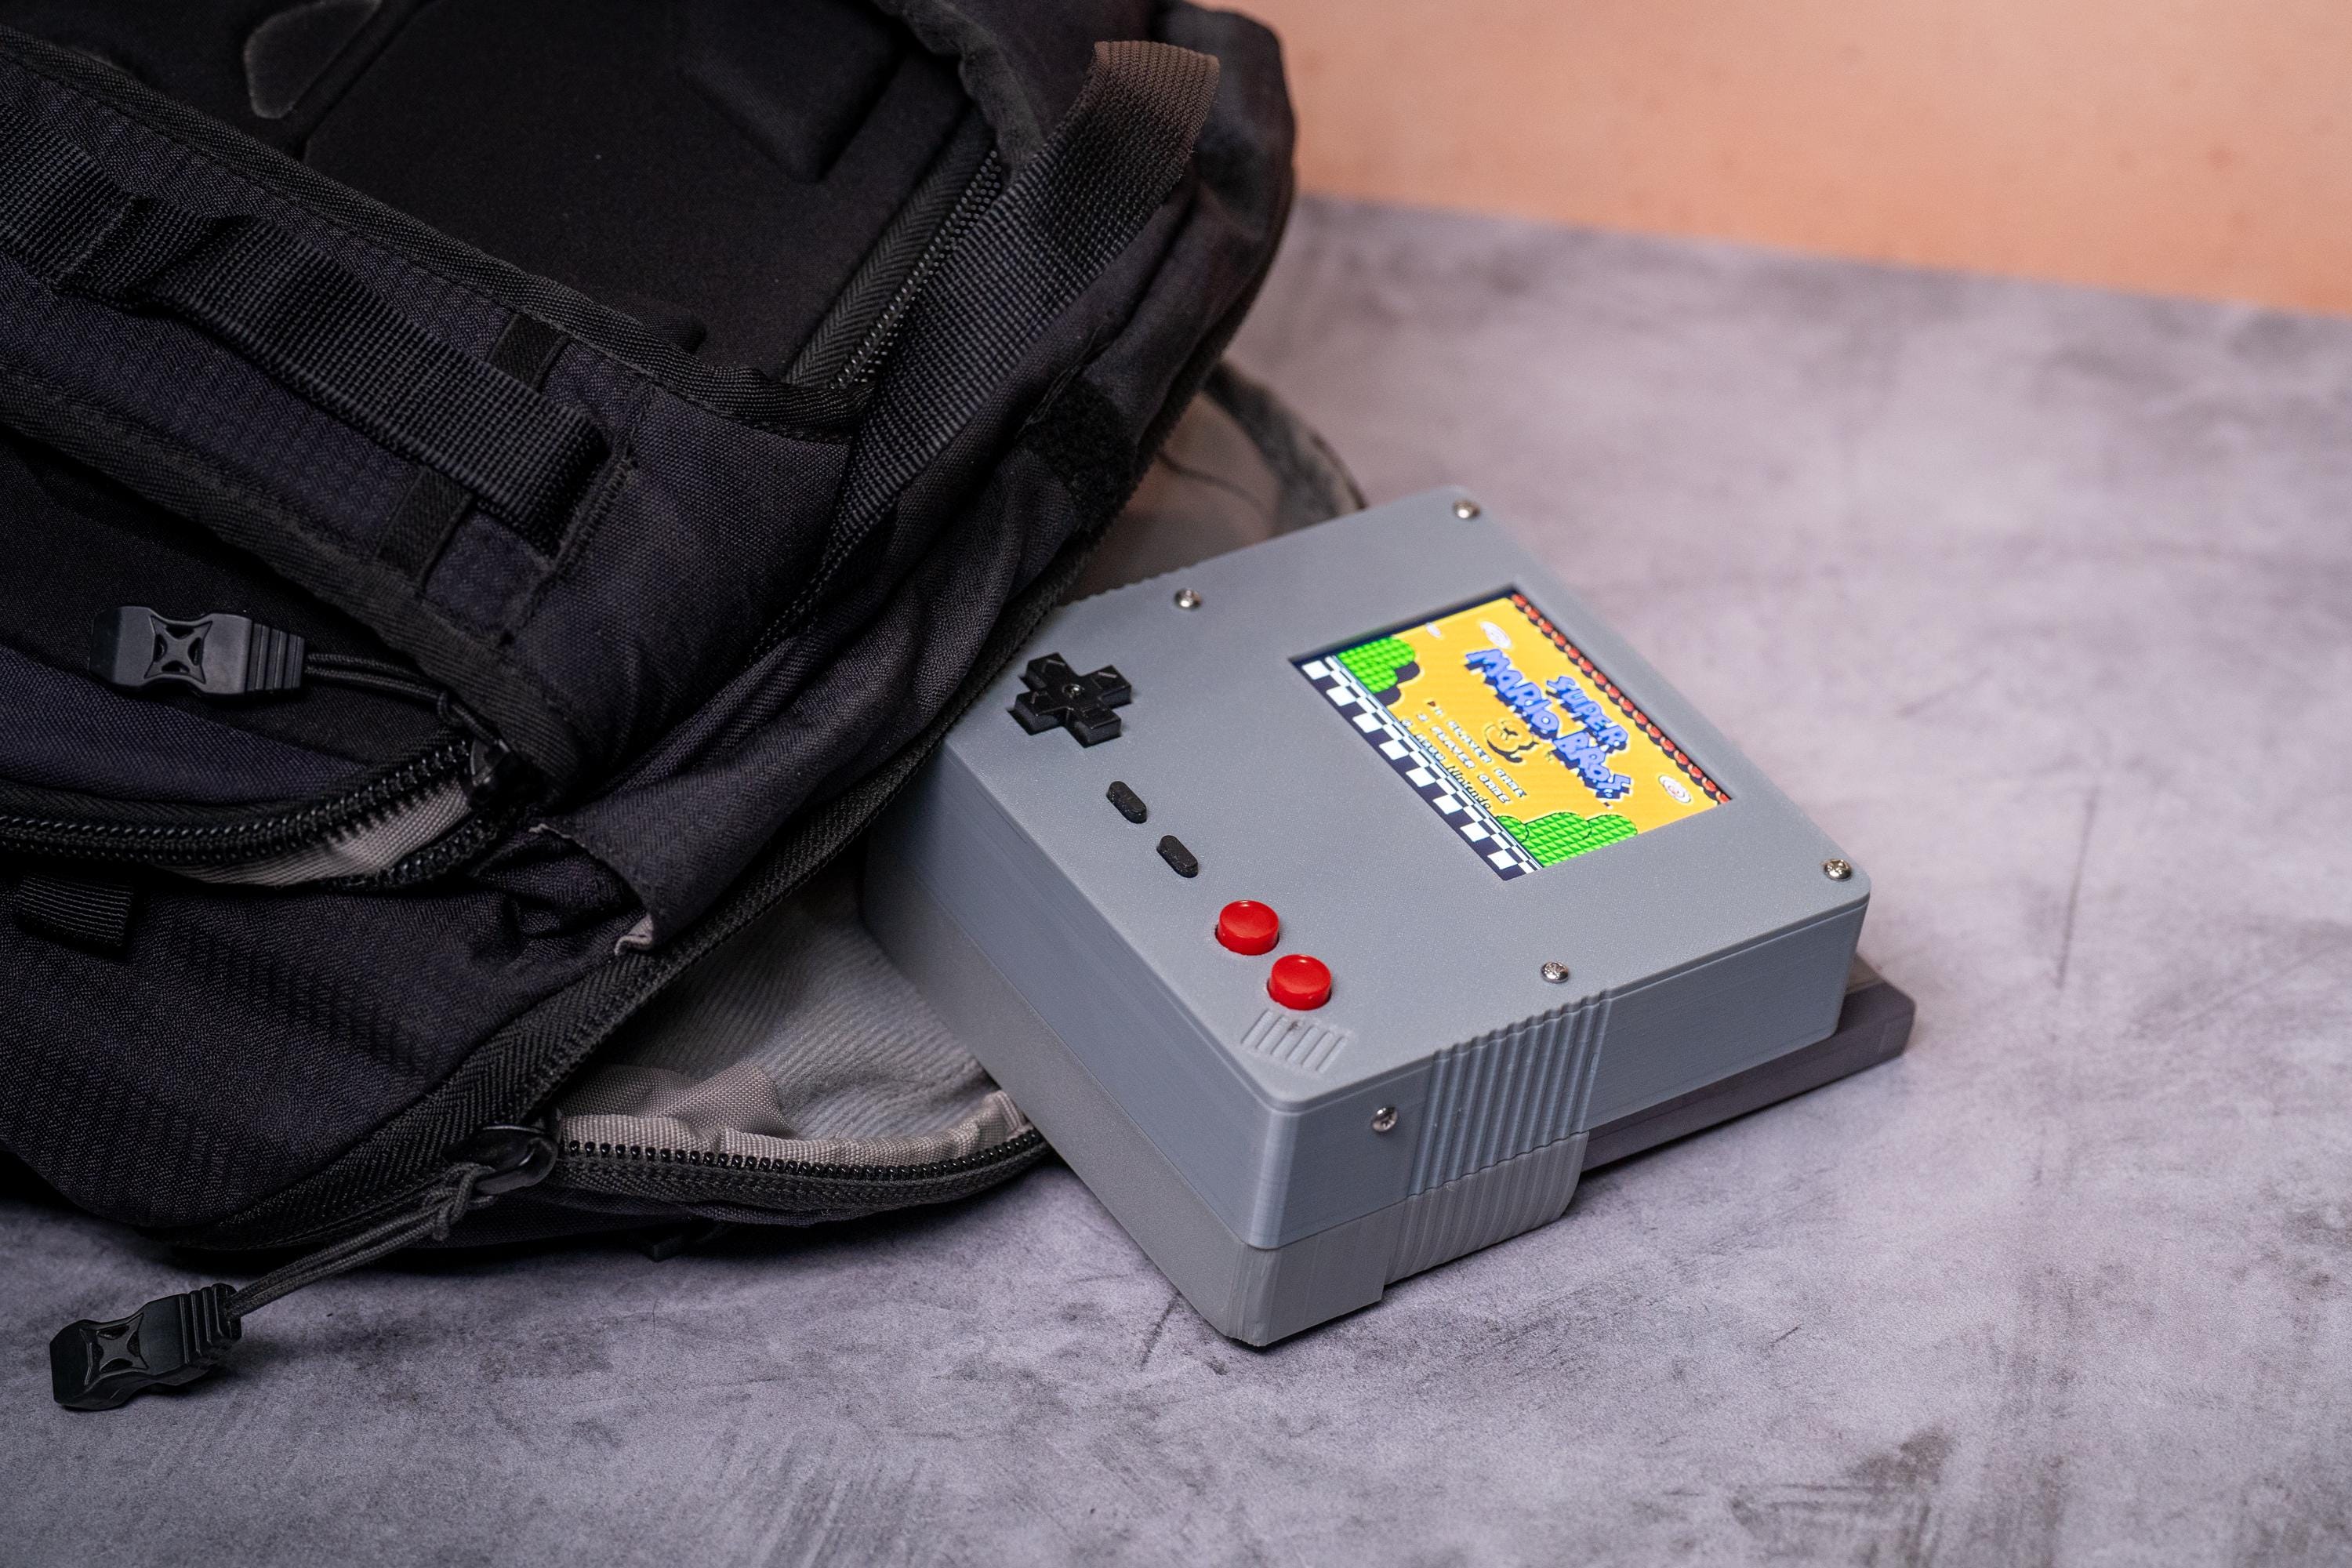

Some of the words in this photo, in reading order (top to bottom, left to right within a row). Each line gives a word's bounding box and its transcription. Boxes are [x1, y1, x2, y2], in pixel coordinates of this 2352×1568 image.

[1465, 649, 1559, 738] MARIO
[1546, 676, 1628, 751] SUPER
[1431, 726, 1475, 768] PLAYER
[1478, 774, 1510, 803] GAME
[1447, 720, 1492, 763] PLAYER
[1494, 768, 1526, 798] GAME
[1485, 719, 1537, 760] 3
